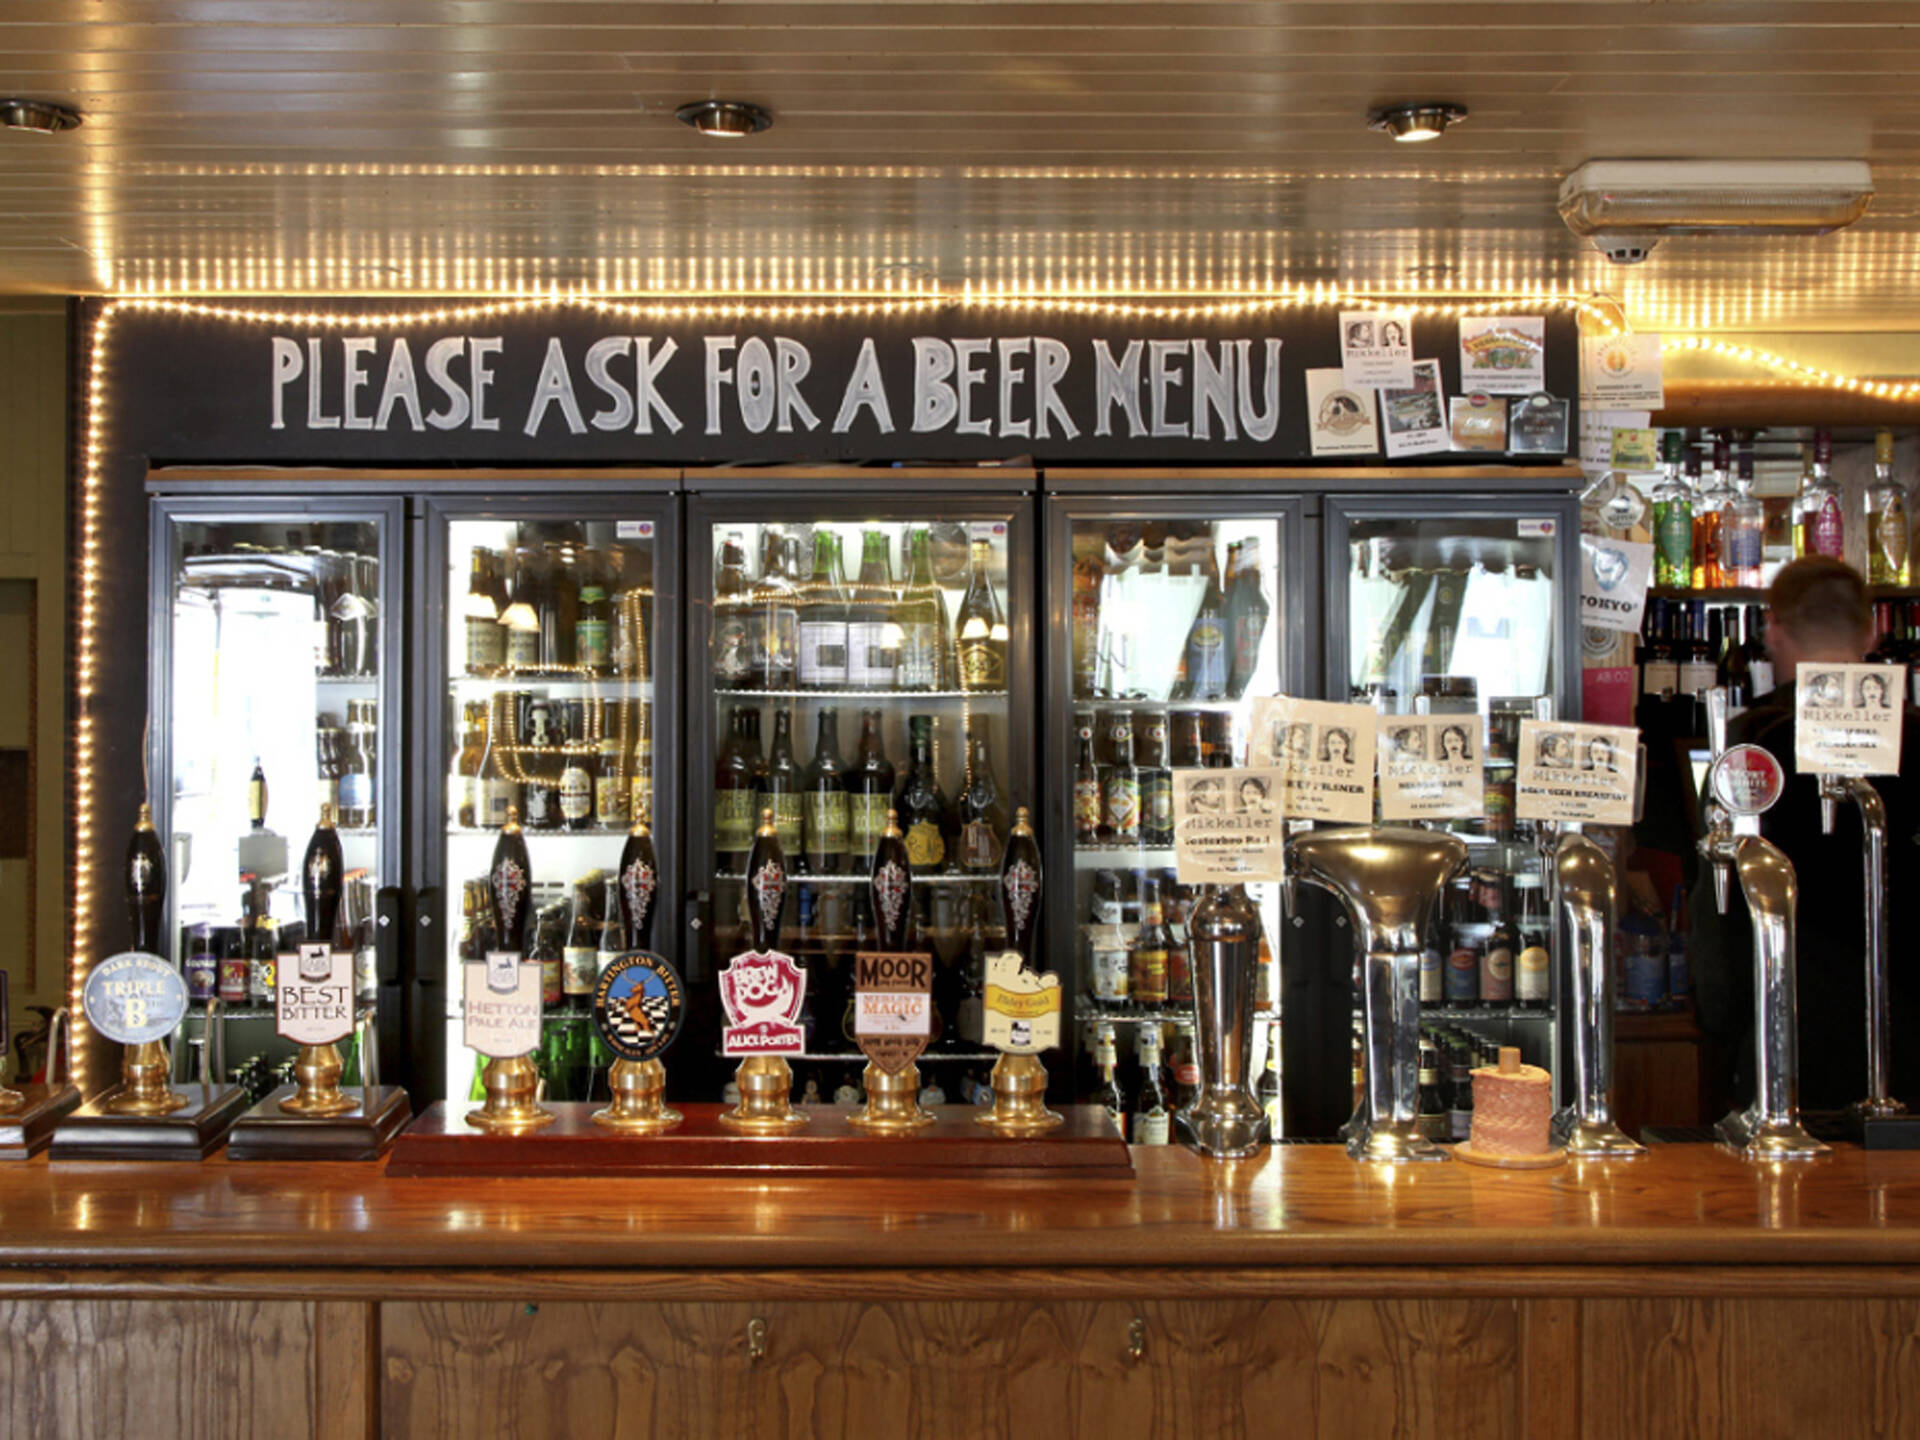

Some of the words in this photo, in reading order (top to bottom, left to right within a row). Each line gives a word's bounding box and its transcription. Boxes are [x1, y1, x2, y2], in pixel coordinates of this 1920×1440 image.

[270, 335, 503, 432] PLEASE
[523, 336, 684, 437] ASK
[704, 335, 822, 434] FOR
[831, 337, 896, 434] A
[911, 336, 1081, 441] BEER
[1091, 338, 1283, 442] MENU
[860, 958, 928, 988] MOOR
[102, 980, 166, 997] TRIPLE
[282, 986, 350, 1006] BEST
[125, 998, 149, 1029] B
[281, 1005, 348, 1021] BITTER
[467, 1000, 539, 1016] HETTON
[863, 1002, 922, 1016] MAGIC
[467, 1015, 505, 1029] PALE
[508, 1018, 538, 1029] ALE
